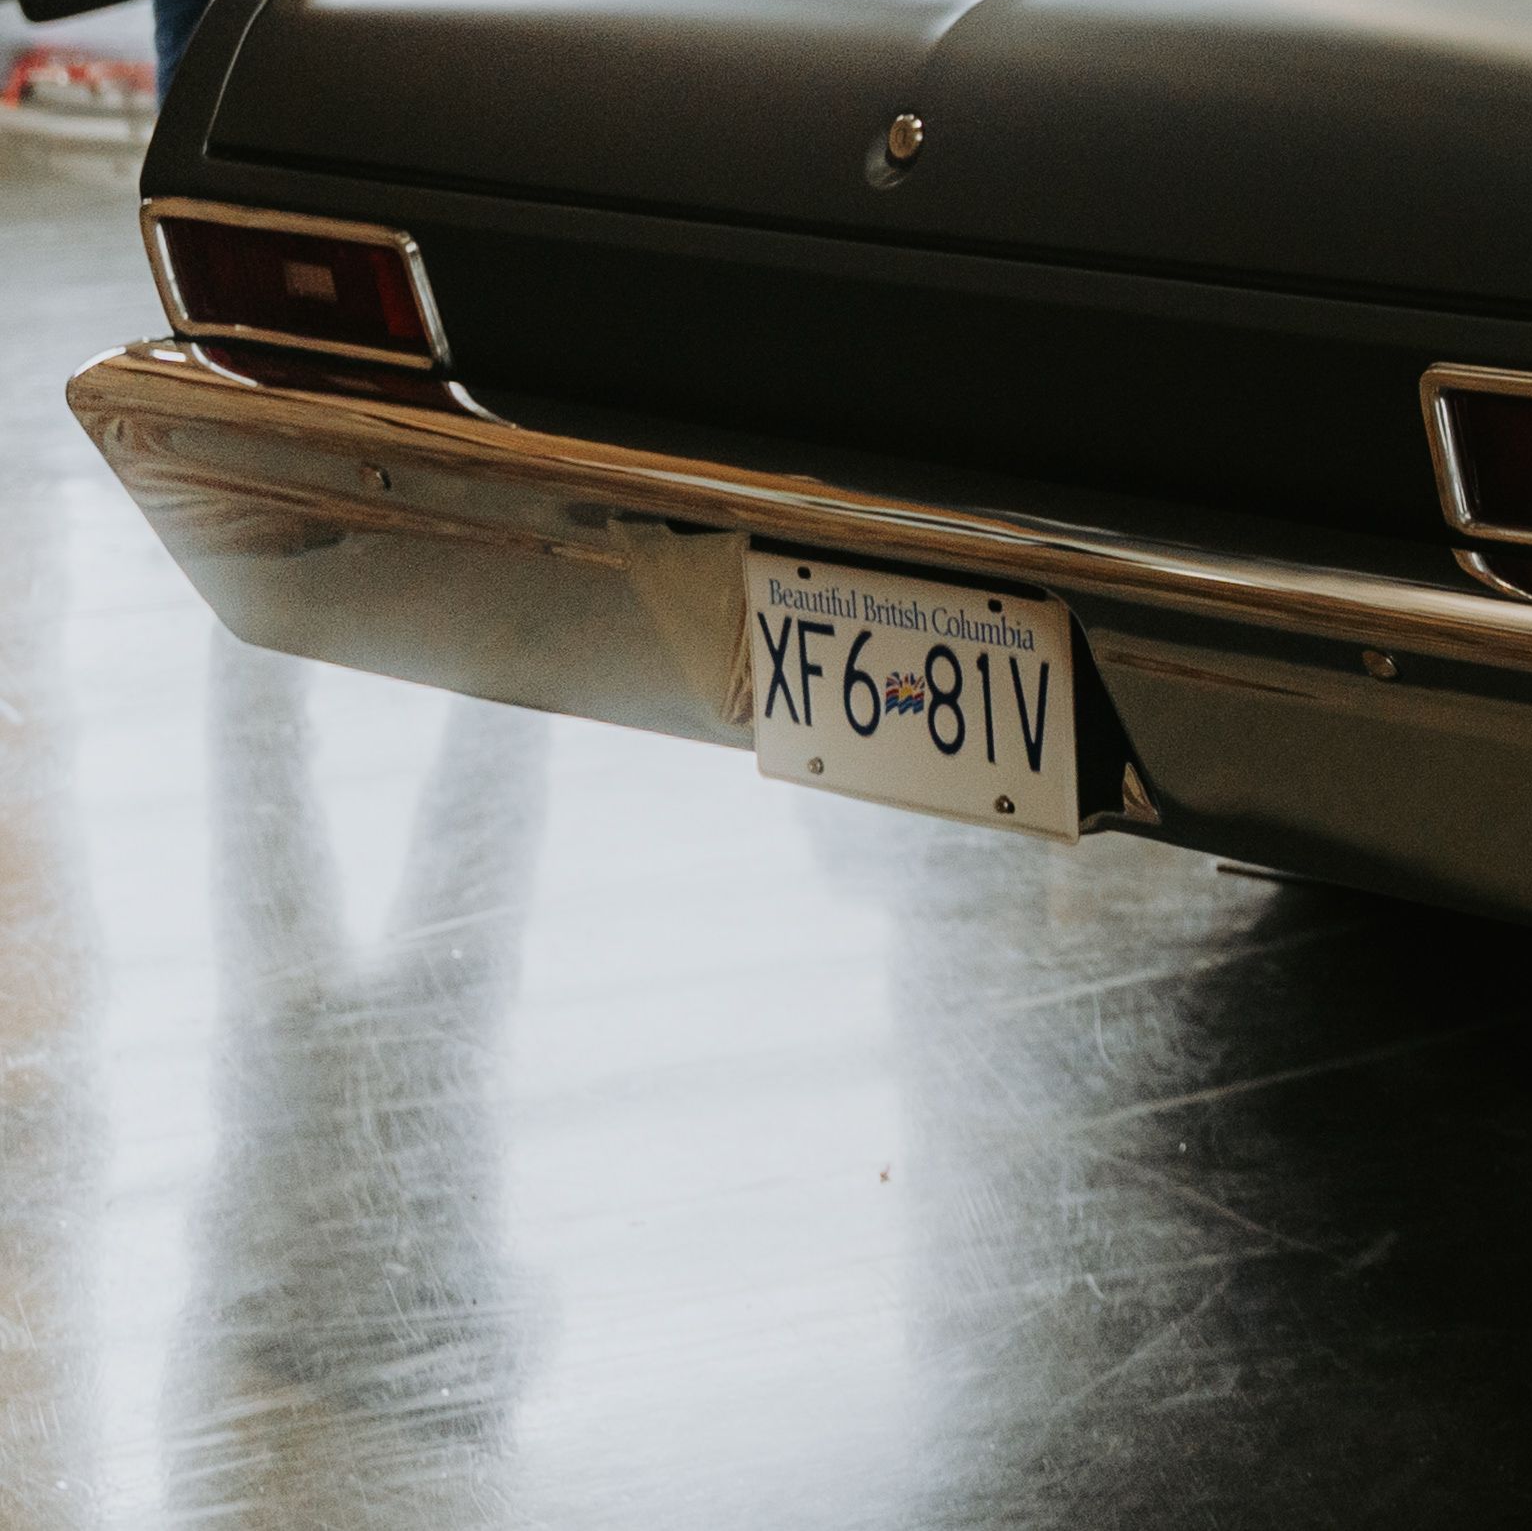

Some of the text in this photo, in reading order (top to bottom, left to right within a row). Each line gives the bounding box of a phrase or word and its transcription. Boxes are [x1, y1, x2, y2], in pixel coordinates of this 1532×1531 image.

[769, 579, 1035, 652] Beautiful British Columbia
